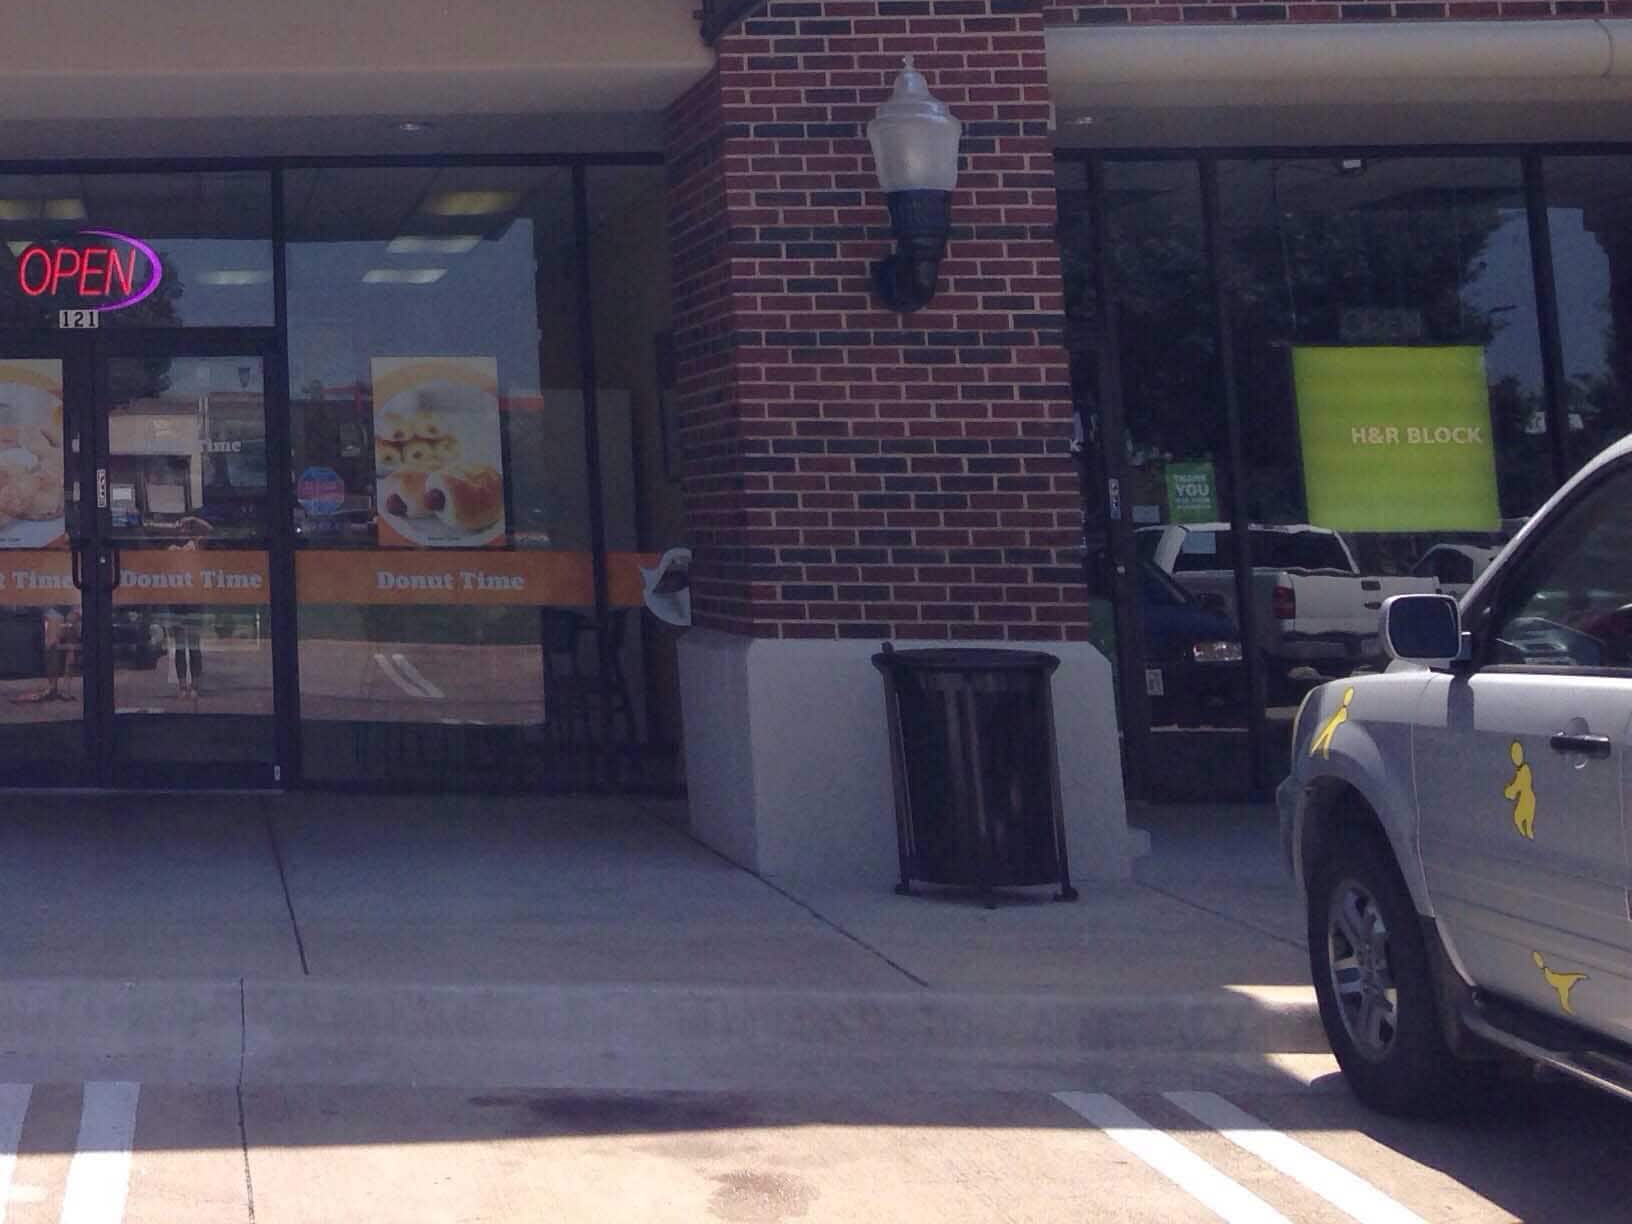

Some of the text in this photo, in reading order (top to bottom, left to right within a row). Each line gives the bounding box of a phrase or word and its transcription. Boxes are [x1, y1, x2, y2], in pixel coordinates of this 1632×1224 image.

[19, 247, 137, 296] OPEN
[63, 311, 96, 327] 121
[1351, 426, 1483, 445] H&R BLOCK
[1175, 484, 1210, 496] YOU
[12, 570, 74, 589] Time
[120, 569, 263, 588] Donut Time
[376, 570, 525, 589] Donut Time
